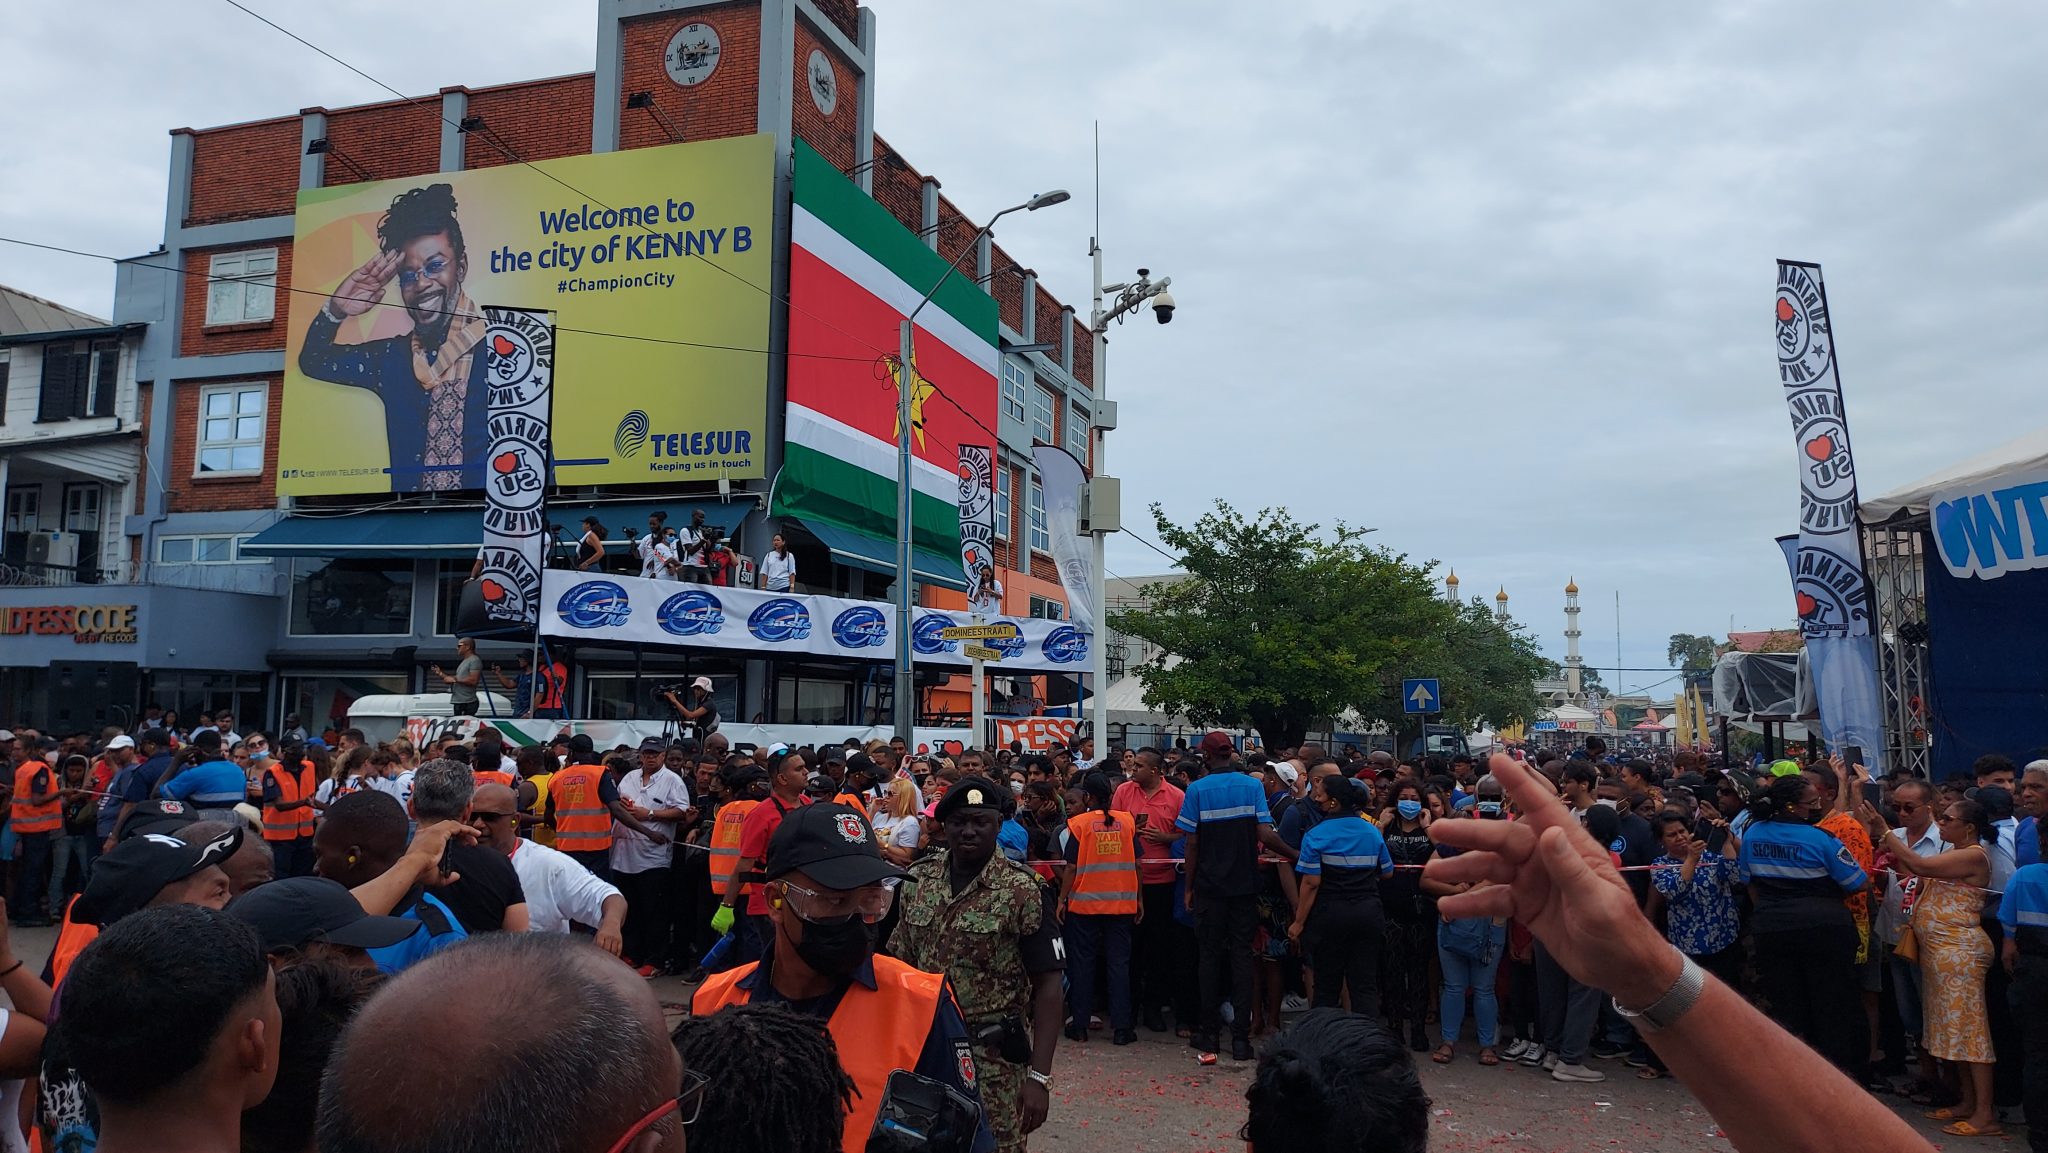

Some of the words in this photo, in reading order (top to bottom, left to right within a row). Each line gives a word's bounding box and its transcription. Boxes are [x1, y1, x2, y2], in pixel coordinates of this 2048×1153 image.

[540, 203, 659, 235] Welcome
[665, 198, 695, 224] to
[490, 247, 533, 274] the
[538, 242, 586, 275] city
[590, 236, 621, 264] of
[626, 228, 728, 261] KENNY
[733, 226, 753, 252] B
[557, 272, 676, 295] #ChampionCity
[650, 429, 752, 457] TELESUR
[650, 461, 691, 472] Keeping
[694, 461, 706, 469] us
[709, 460, 719, 468] in
[721, 458, 751, 468] touch
[577, 601, 632, 615] Basic
[675, 611, 726, 624] Basic
[945, 627, 1008, 637] DOMINEESTRAAT
[1097, 832, 1121, 843] YARI
[1097, 842, 1121, 854] FEST
[1752, 842, 1800, 860] SECURITY
